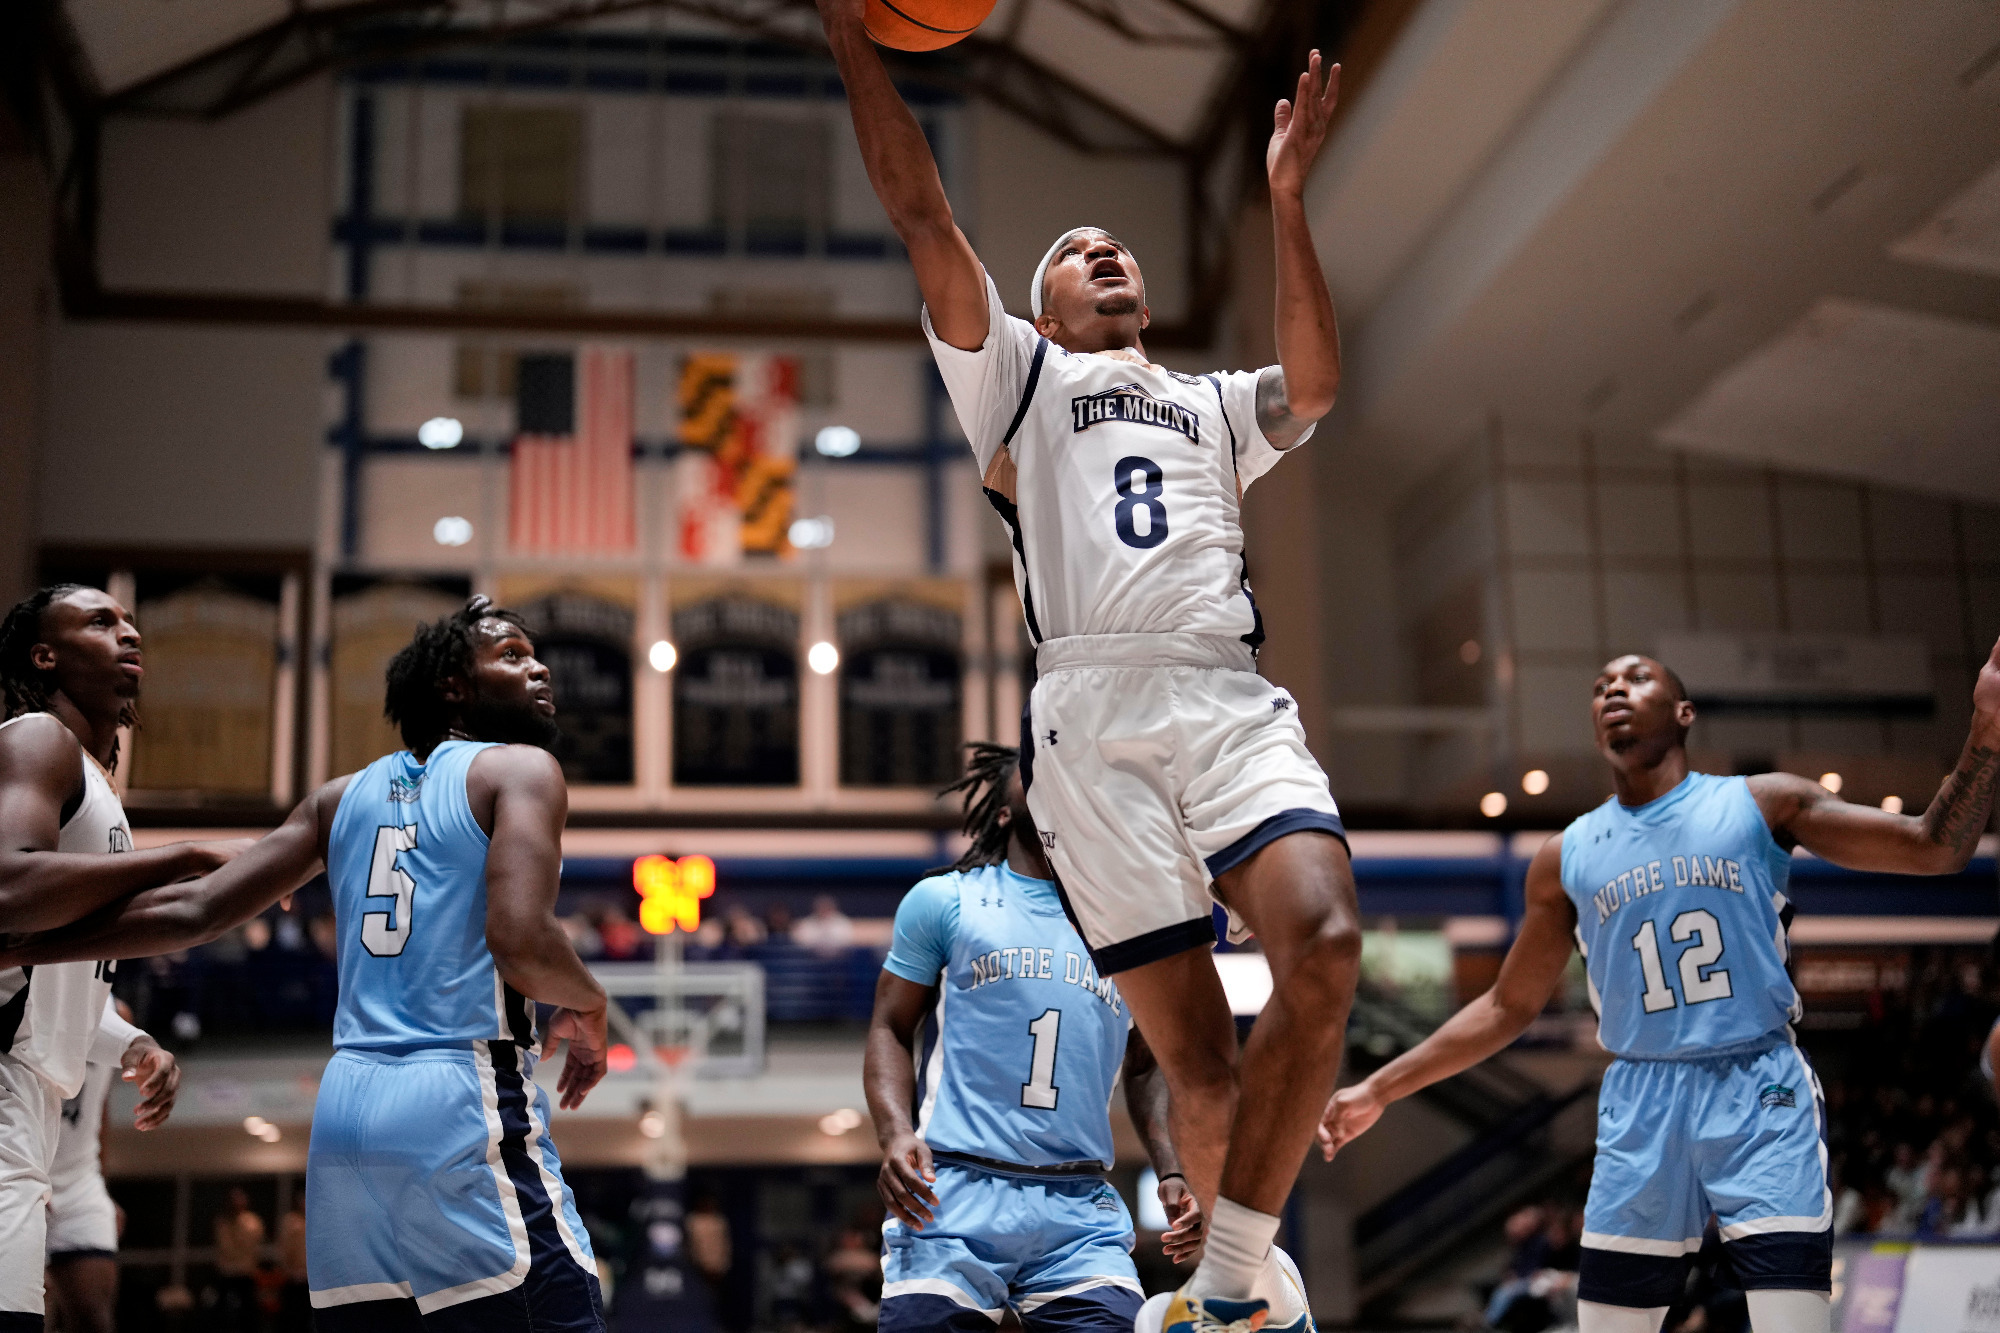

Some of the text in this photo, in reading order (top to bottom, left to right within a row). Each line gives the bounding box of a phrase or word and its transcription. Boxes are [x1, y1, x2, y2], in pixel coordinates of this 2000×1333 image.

[1073, 396, 1198, 440] THE MOUNT
[1114, 455, 1169, 550] 8
[360, 821, 418, 958] 5
[1593, 854, 1745, 926] NOTRE DAME
[970, 947, 1054, 992] NOTRE
[1631, 907, 1734, 1014] 12
[1020, 1007, 1062, 1111] 1
